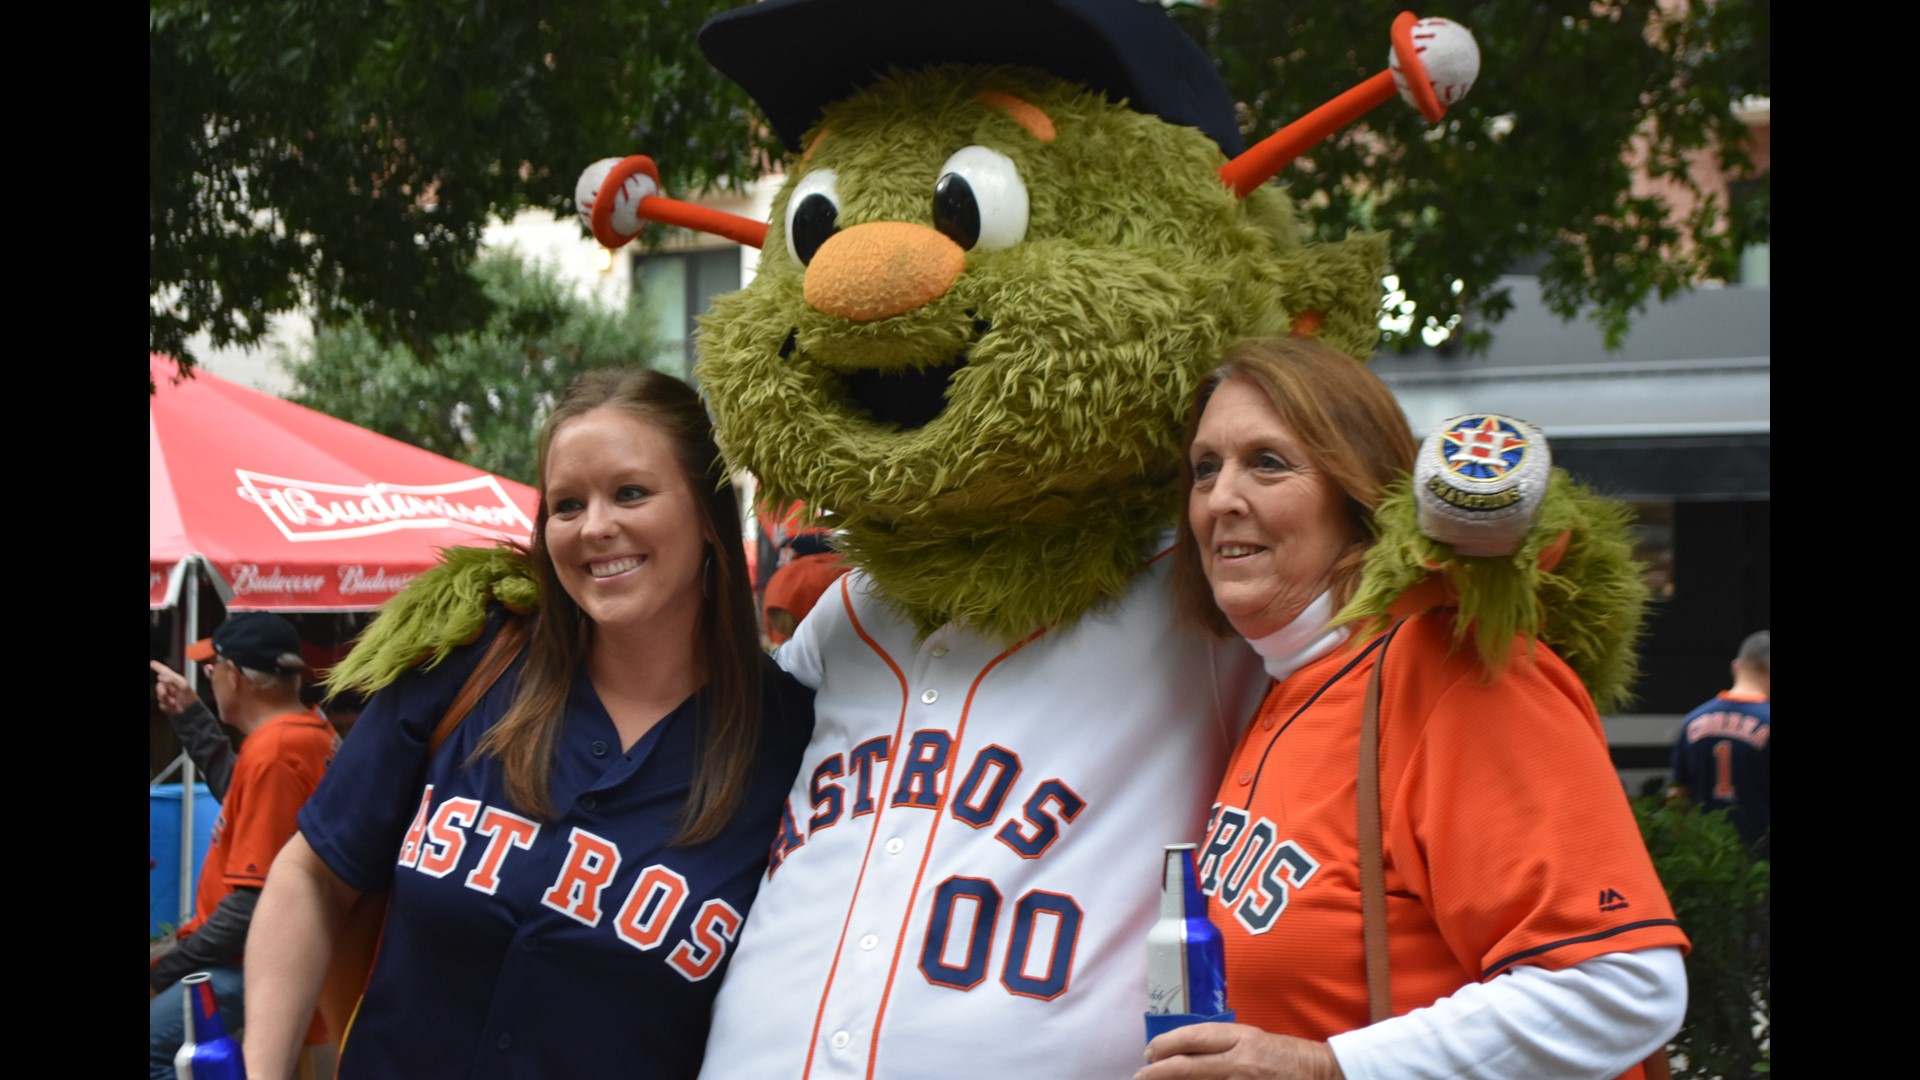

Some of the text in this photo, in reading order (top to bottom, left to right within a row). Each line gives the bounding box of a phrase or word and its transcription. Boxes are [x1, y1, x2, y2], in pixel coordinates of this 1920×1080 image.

[768, 728, 1088, 882] ASTROS
[1712, 740, 1737, 800] 1
[398, 783, 744, 983] ASTROS
[1197, 802, 1321, 936] ROS
[917, 874, 1084, 1003] 00
